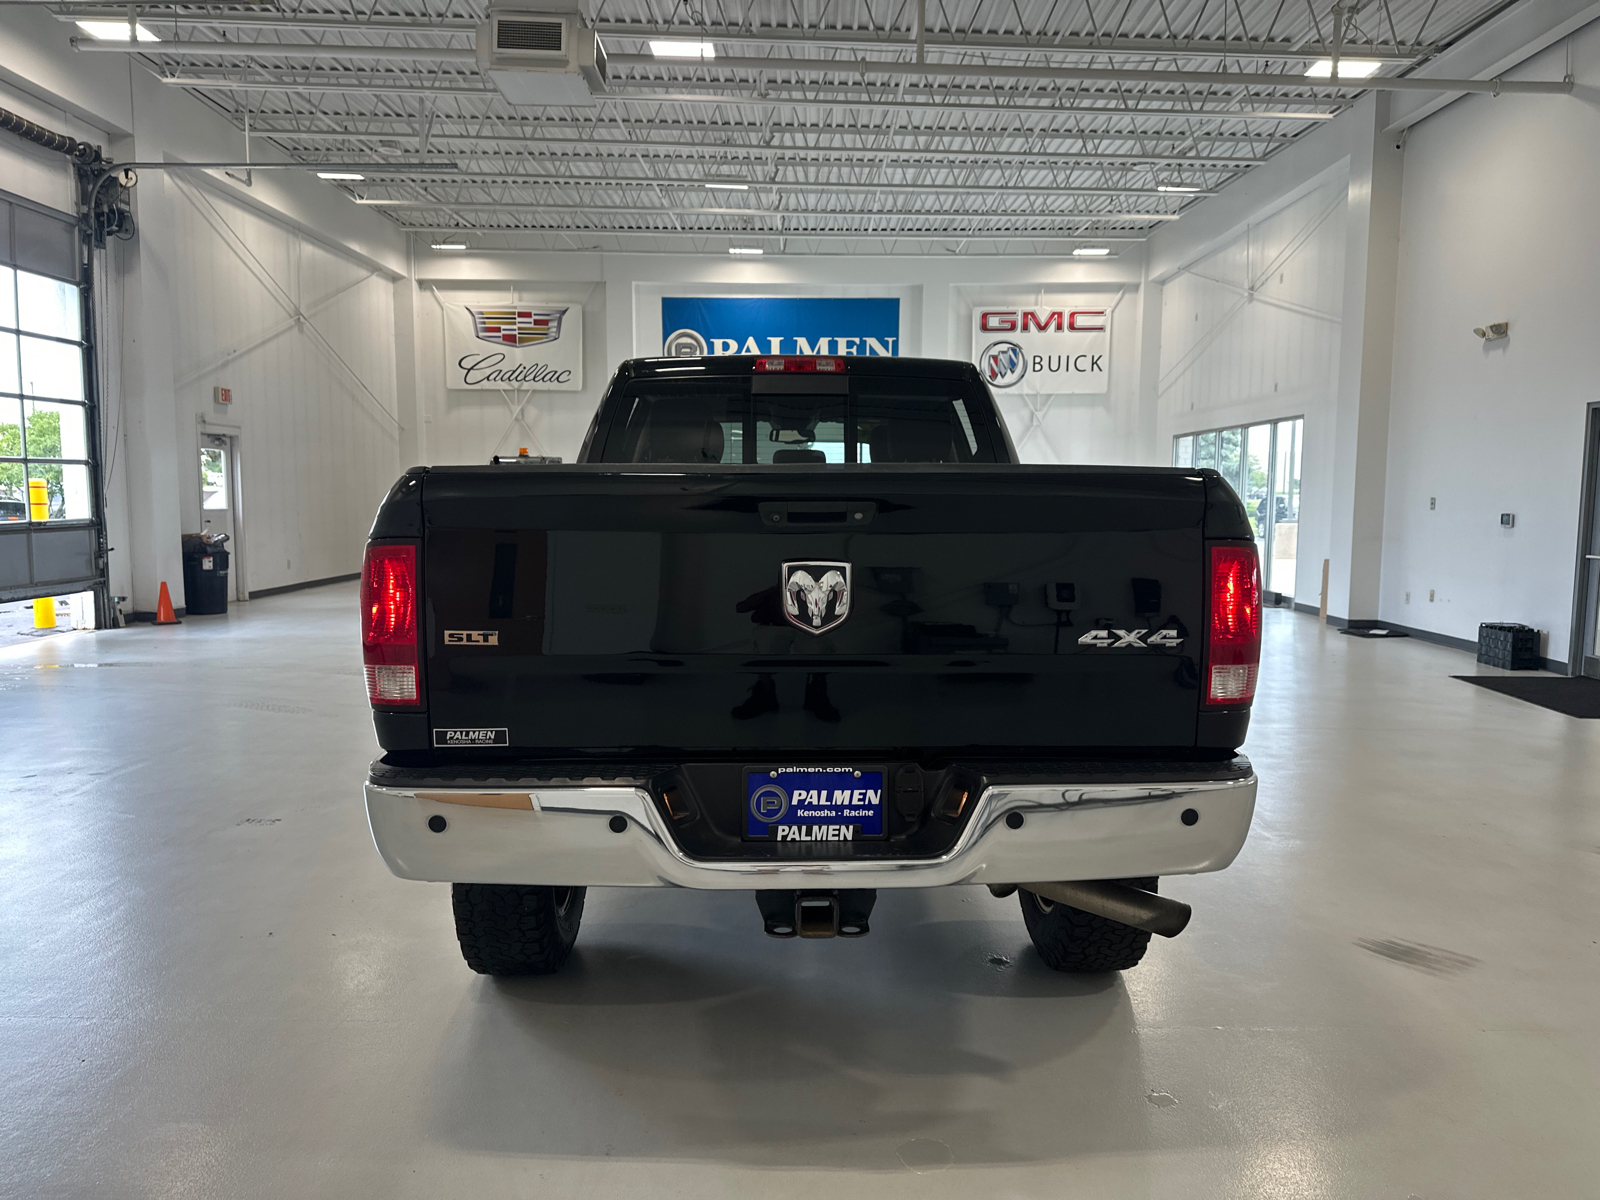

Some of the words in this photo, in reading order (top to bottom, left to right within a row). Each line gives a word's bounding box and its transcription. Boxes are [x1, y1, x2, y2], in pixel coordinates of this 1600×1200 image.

[980, 310, 1107, 333] GMC
[458, 352, 572, 385] Cadillac
[1032, 354, 1103, 373] BUICK
[448, 633, 494, 643] SLT
[446, 731, 496, 740] PALMEN
[778, 766, 853, 774] palmen.com
[791, 789, 881, 806] PALMEN
[797, 809, 836, 817] Kenosha
[843, 809, 874, 817] Racine
[777, 825, 853, 841] PALMEN
